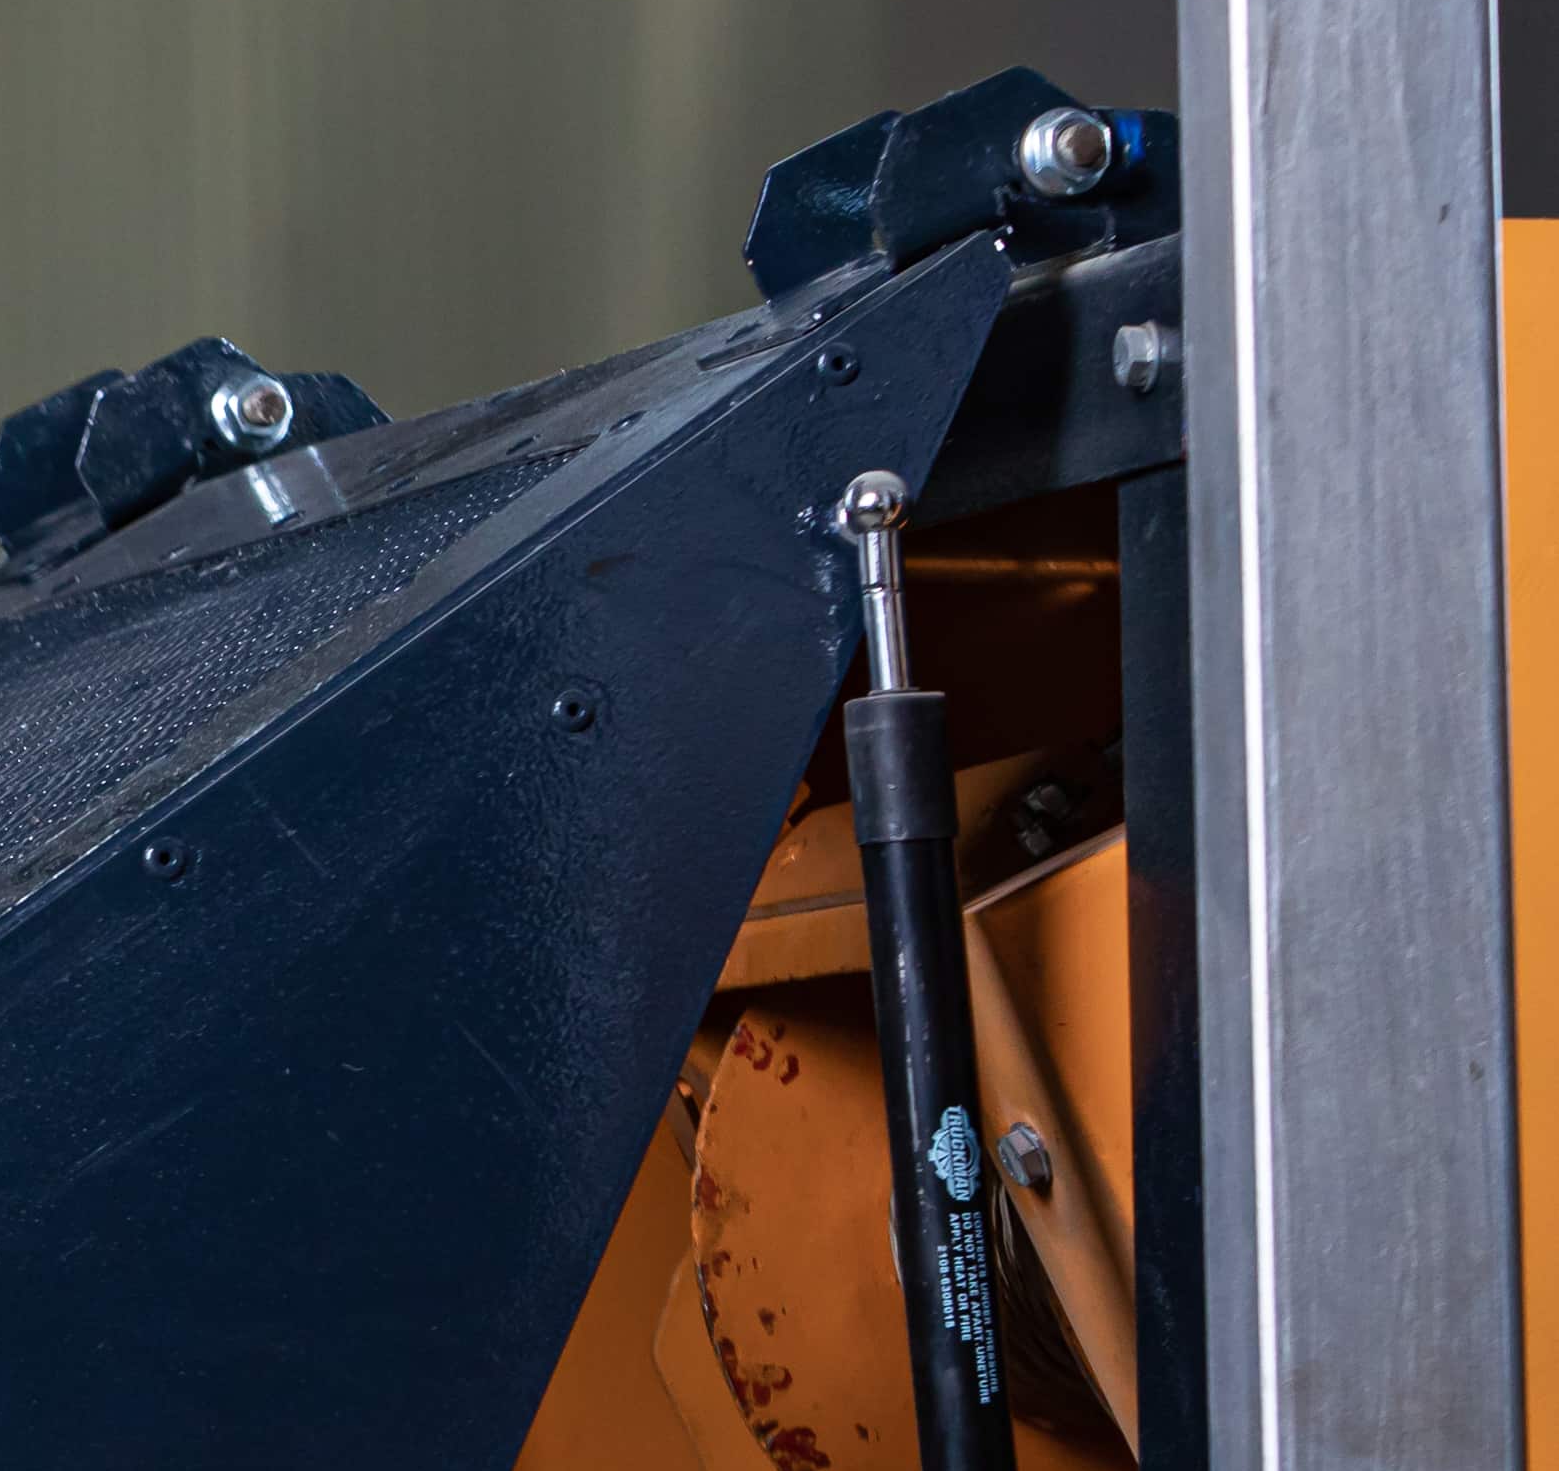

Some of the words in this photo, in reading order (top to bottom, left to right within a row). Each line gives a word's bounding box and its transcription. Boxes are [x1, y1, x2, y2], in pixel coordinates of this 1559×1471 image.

[946, 1105, 970, 1202] TRUCKMAN
[948, 1212, 962, 1252] APPLY
[961, 1212, 972, 1230] DO
[963, 1233, 975, 1260] NOT
[953, 1256, 966, 1288] HEAT
[966, 1264, 979, 1296] TAKE
[956, 1292, 968, 1310] OR
[979, 1281, 992, 1324] UNDER
[959, 1314, 971, 1340] FIRE
